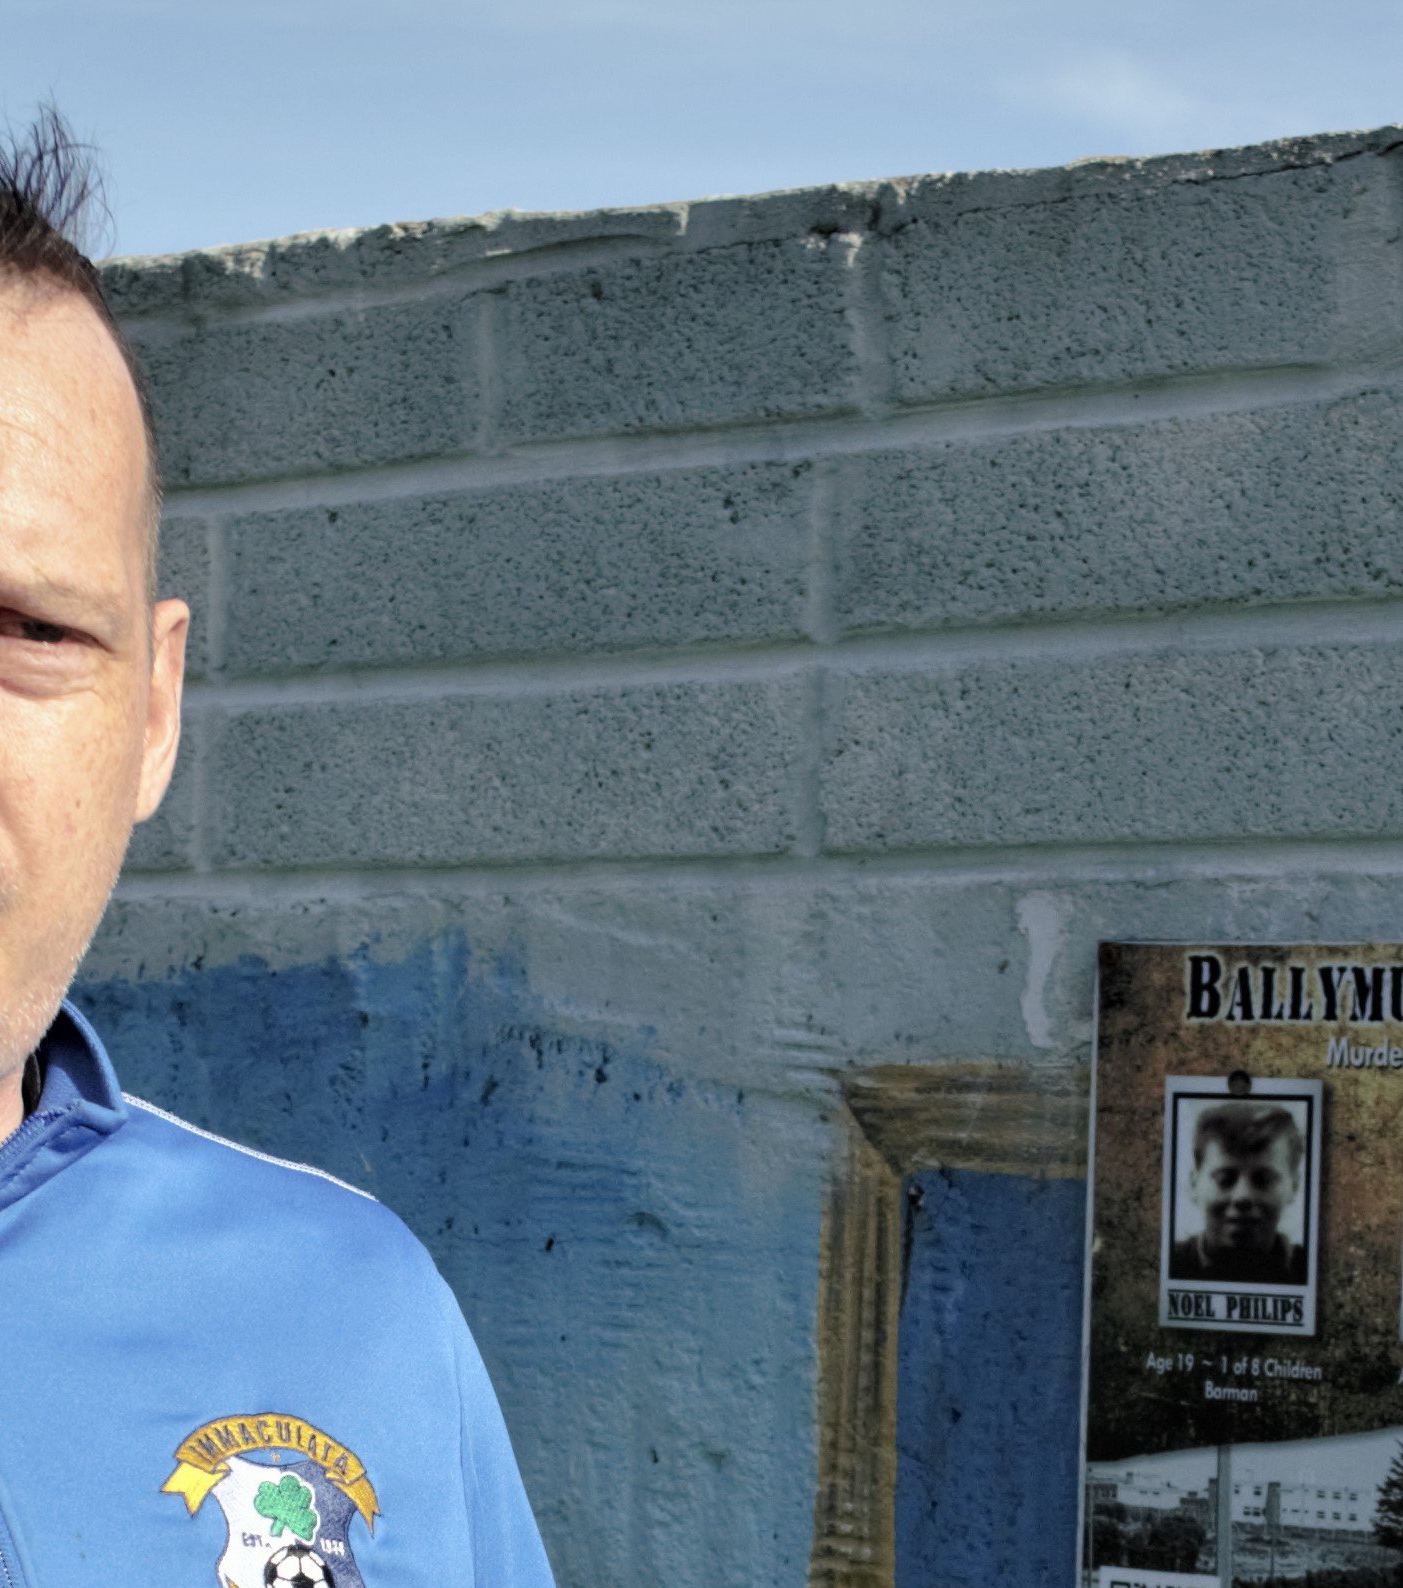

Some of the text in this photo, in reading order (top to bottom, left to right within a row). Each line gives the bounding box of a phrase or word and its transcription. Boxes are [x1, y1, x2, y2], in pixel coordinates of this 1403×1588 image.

[1167, 1292, 1216, 1319] NOEL
[1146, 1351, 1173, 1375] Age
[1178, 1352, 1195, 1373] 19
[1221, 1355, 1228, 1375] 1
[1233, 1356, 1248, 1376] of
[1251, 1357, 1261, 1376] 8
[1264, 1358, 1323, 1380] Children
[1204, 1379, 1259, 1402] Barman
[188, 1420, 349, 1476] IMMACULATA
